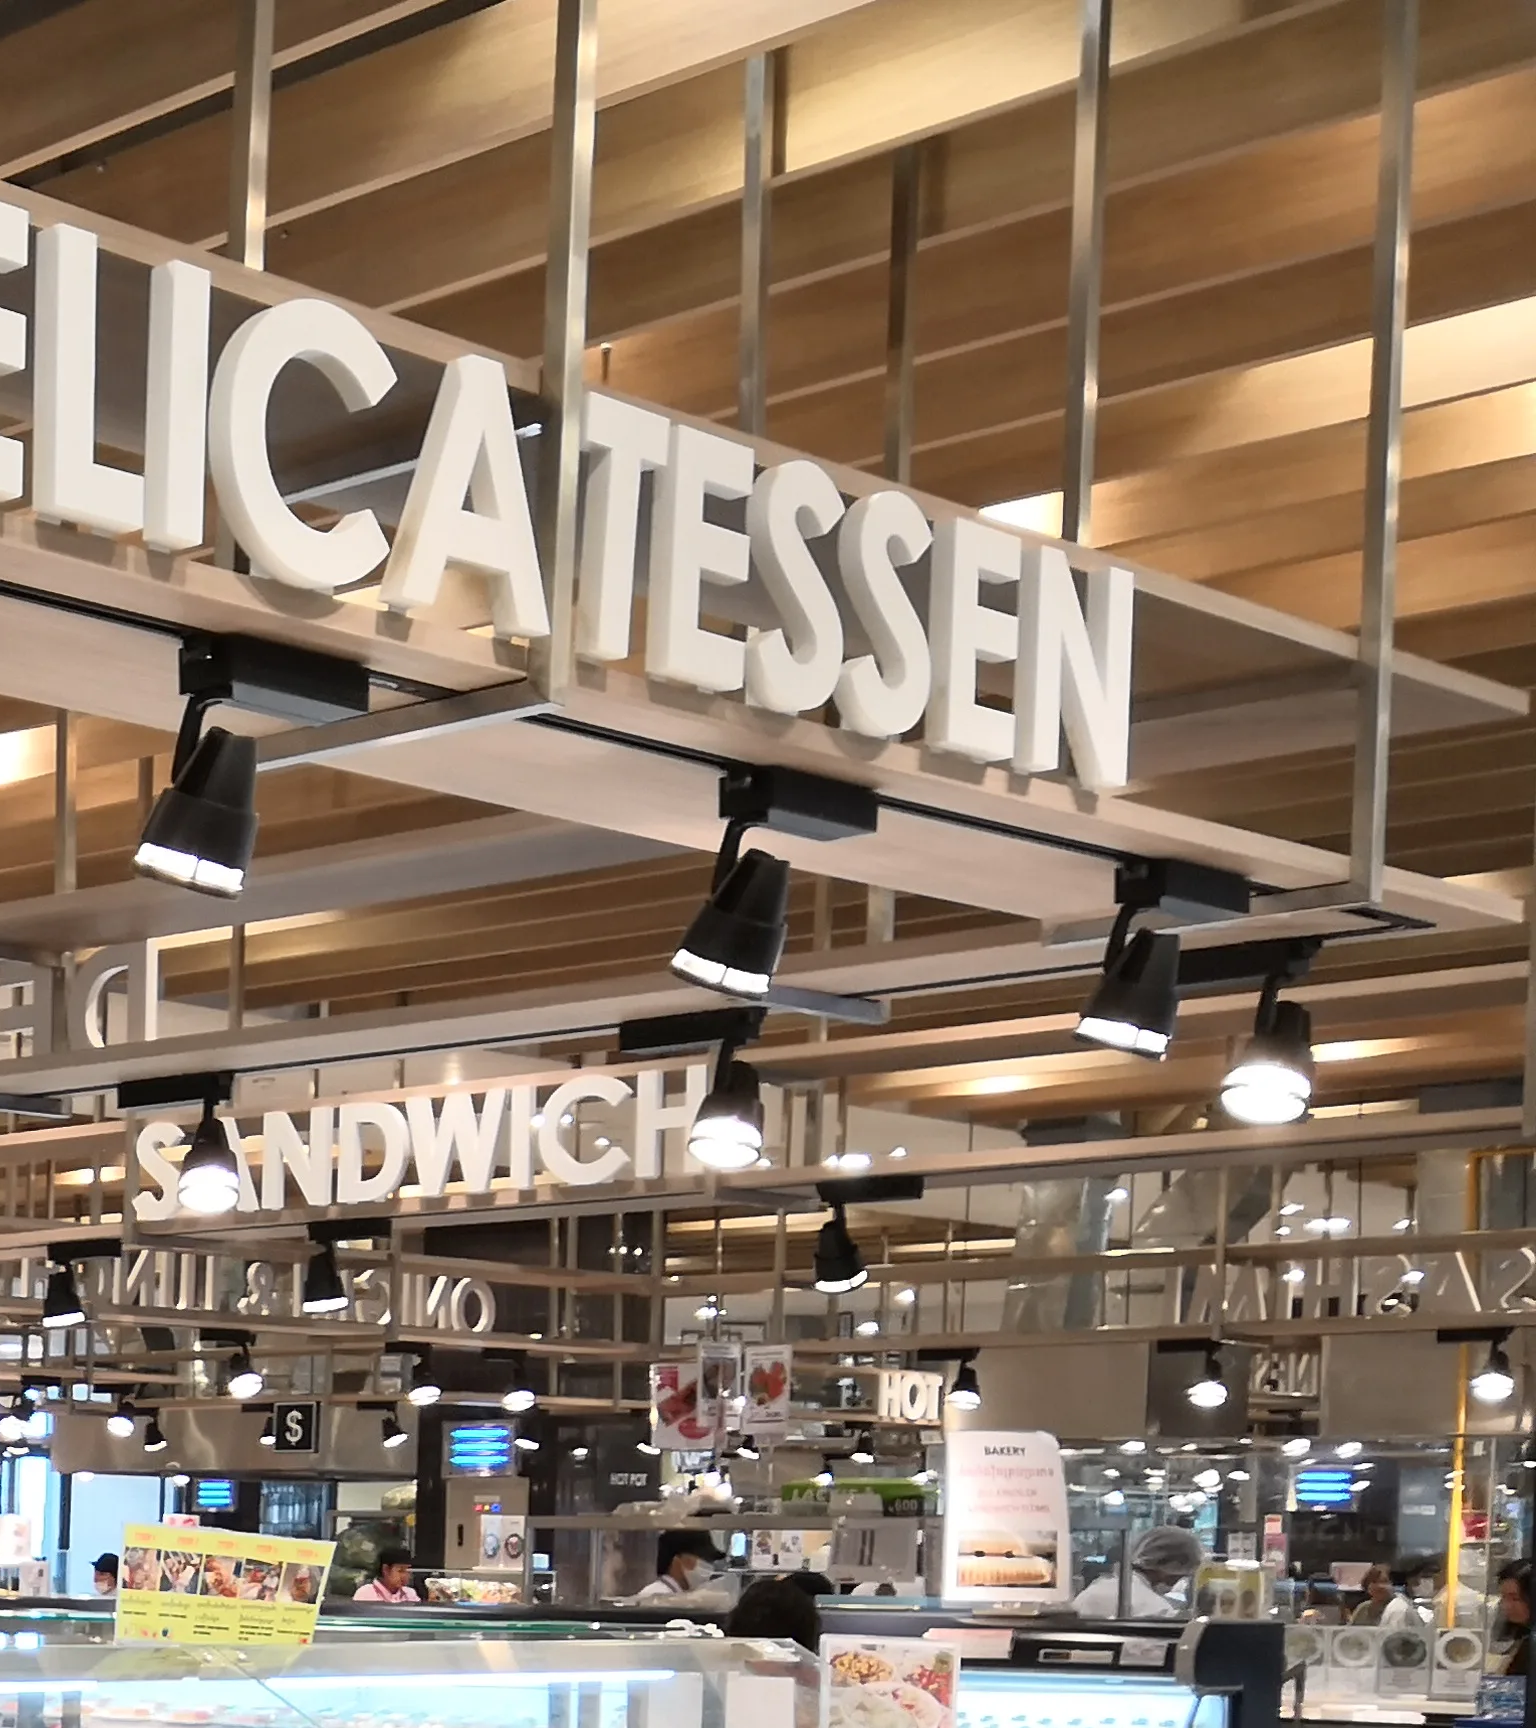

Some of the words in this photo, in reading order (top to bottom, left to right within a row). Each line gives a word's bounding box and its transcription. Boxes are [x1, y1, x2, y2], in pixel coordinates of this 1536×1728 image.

[878, 1371, 944, 1421] HOT
[984, 1446, 1026, 1457] BAKERY
[610, 1472, 629, 1486] HOT
[629, 1473, 648, 1487] POT
